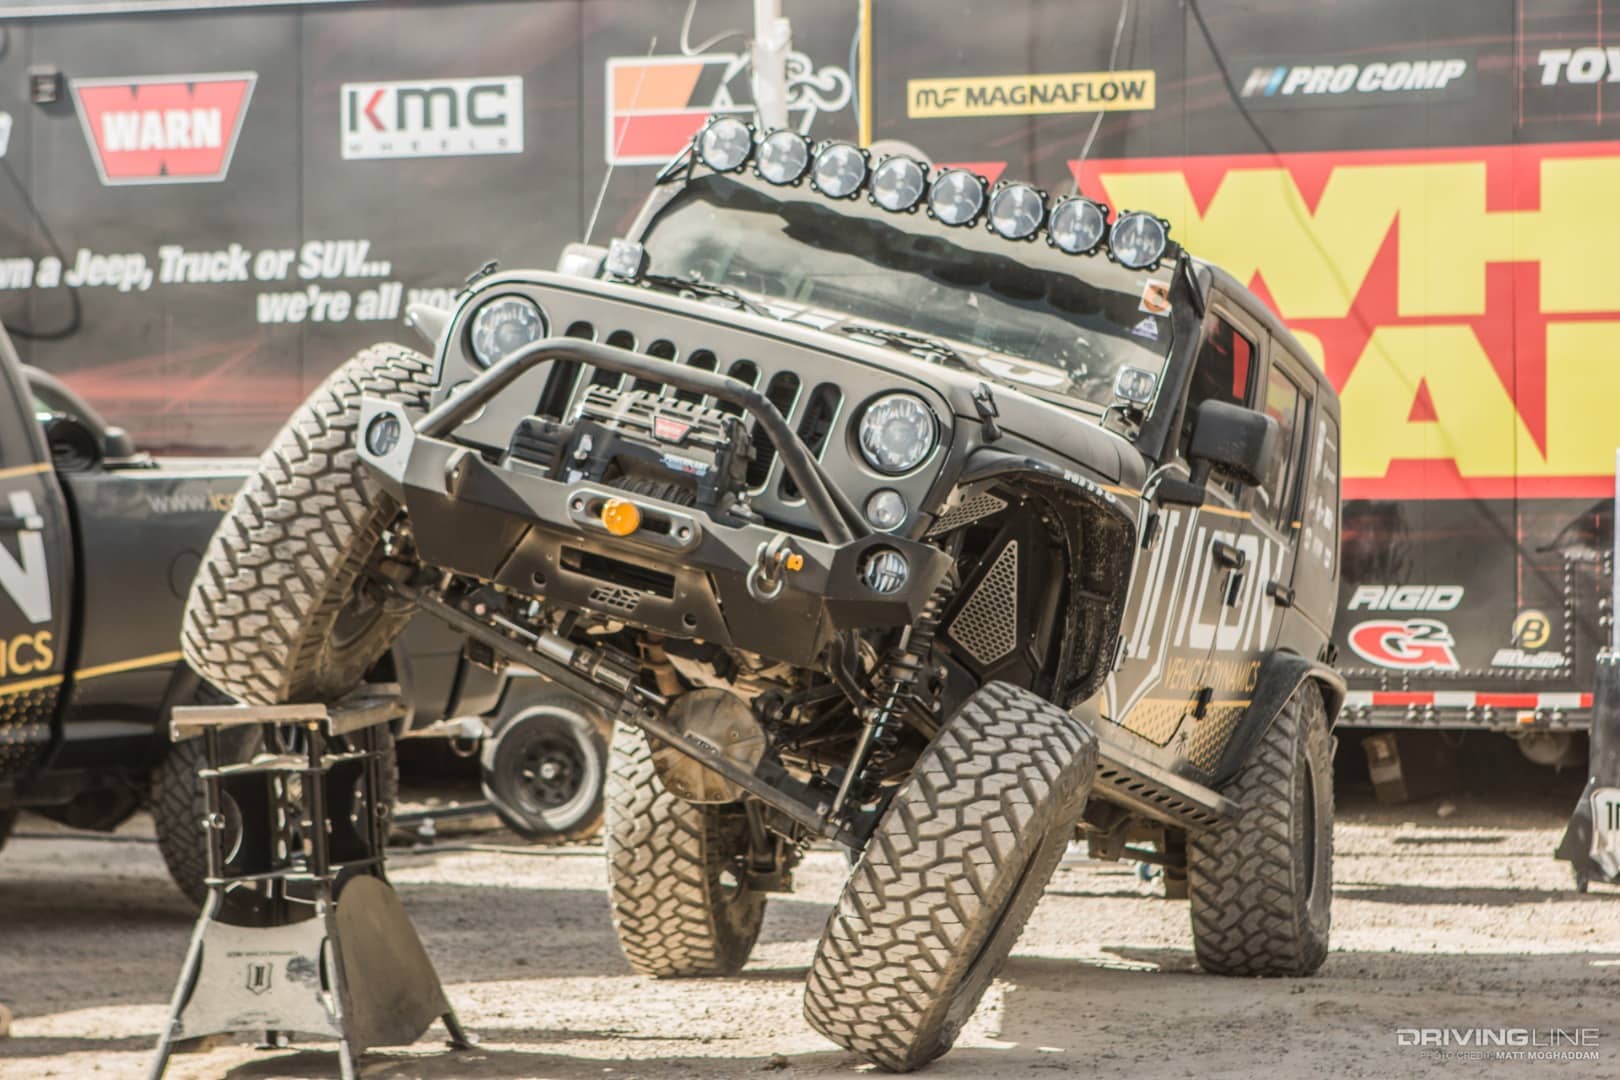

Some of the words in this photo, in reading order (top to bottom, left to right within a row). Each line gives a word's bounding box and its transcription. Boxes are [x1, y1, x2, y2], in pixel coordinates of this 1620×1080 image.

[965, 79, 1147, 107] MAGNAFLOW
[1281, 65, 1359, 95] PRO
[1357, 59, 1466, 92] COMP
[101, 109, 221, 151] WARN
[36, 256, 61, 288] a
[64, 247, 153, 292] Jeep,
[159, 242, 251, 283] Truck
[254, 249, 295, 281] or
[297, 239, 391, 280] SUV...
[256, 284, 351, 324] we're
[354, 282, 403, 320] all
[1347, 585, 1464, 611] RIGID
